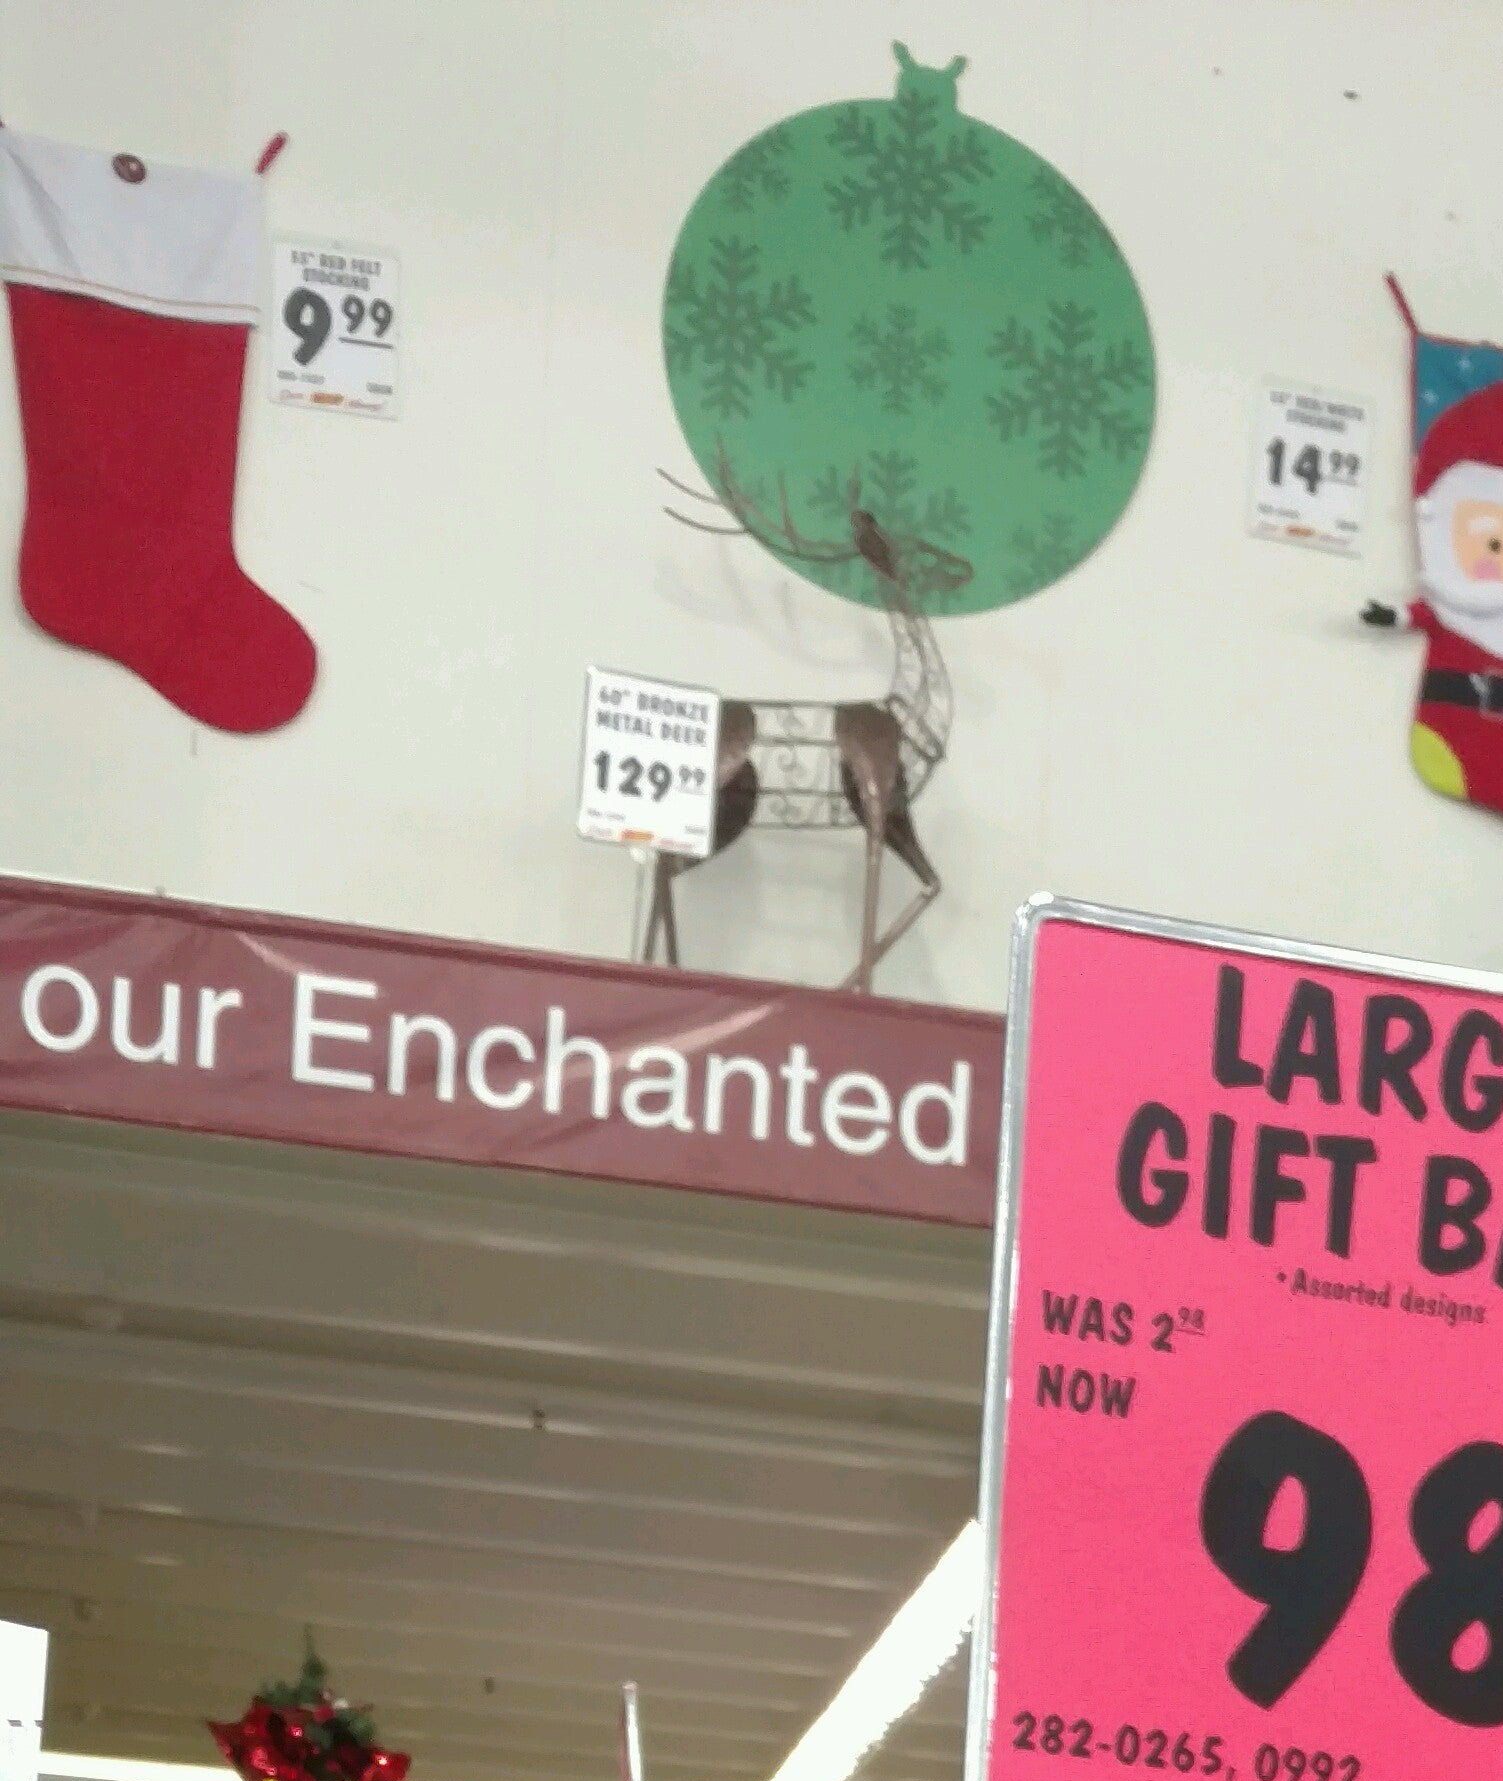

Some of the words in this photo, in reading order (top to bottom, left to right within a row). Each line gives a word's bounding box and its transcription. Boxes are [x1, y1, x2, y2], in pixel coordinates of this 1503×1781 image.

[21, 963, 241, 1071] our
[289, 973, 973, 1167] Enchanted
[1115, 1101, 1378, 1259] GIFT
[1041, 1289, 1134, 1346] WAS
[1399, 1287, 1487, 1327] designs
[1036, 1363, 1136, 1418] NOW
